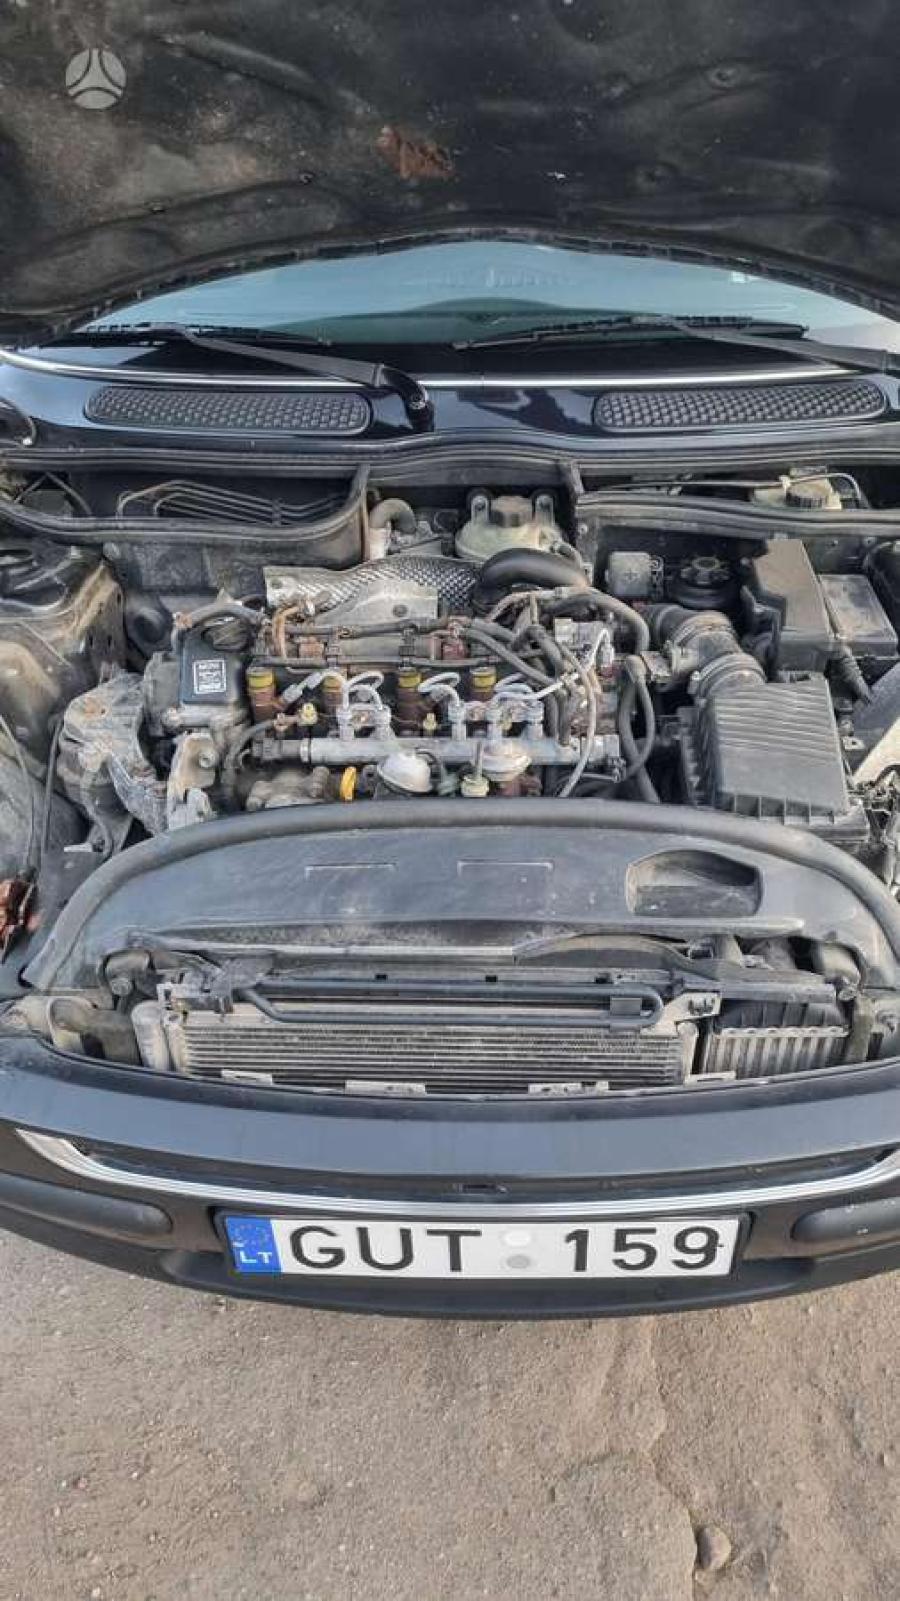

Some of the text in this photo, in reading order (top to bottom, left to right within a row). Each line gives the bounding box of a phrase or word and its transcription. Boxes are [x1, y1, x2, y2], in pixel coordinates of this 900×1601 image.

[239, 1250, 273, 1264] LT
[289, 1225, 720, 1273] GUT 159
